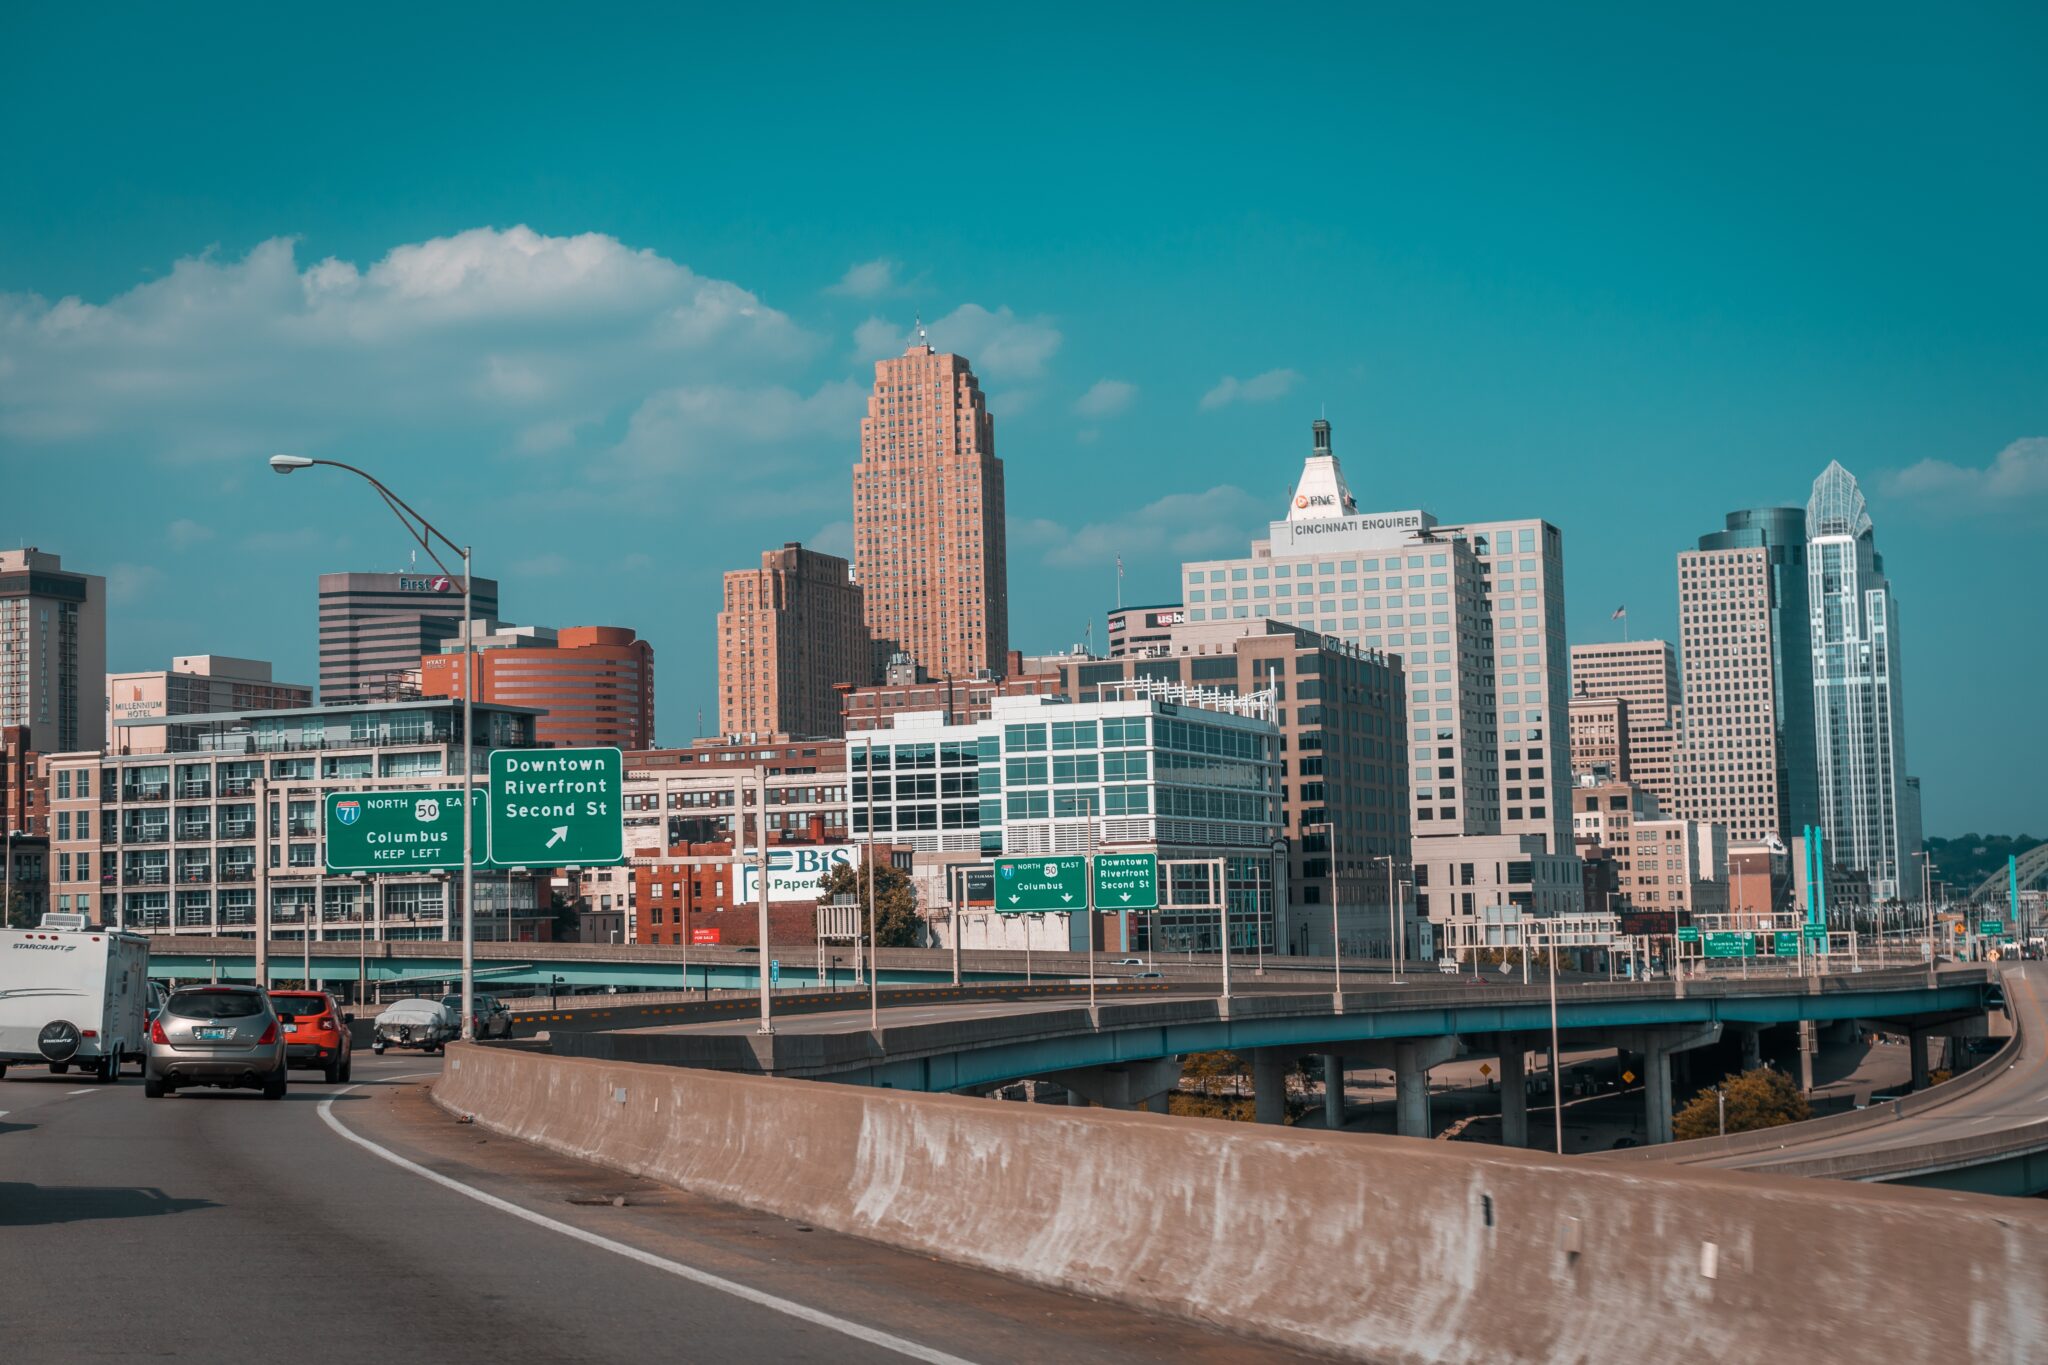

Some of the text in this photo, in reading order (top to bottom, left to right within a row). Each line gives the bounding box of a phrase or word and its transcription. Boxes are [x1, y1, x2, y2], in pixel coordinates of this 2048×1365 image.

[1310, 494, 1335, 507] PNC
[1295, 516, 1419, 536] CINCINNATI ENQUIRER
[399, 576, 431, 591] First
[426, 658, 447, 666] HYATT
[115, 701, 162, 711] MILLENNIUM
[127, 710, 152, 718] HOTEL
[506, 757, 605, 773] Downtown
[505, 778, 607, 795] Riverfront
[341, 797, 478, 821] 71 NORTH 50 EAT
[506, 801, 607, 818] Second St
[366, 830, 448, 844] Columbus
[374, 848, 441, 859] KEEP LEFT
[1101, 858, 1149, 867] Downtown
[1003, 867, 1012, 877] 71
[1045, 866, 1057, 875] 50
[1061, 861, 1079, 869] EAST
[1100, 868, 1150, 878] Riverfront
[1017, 882, 1063, 891] Columbus
[1101, 879, 1150, 890] Second St
[13, 943, 66, 951] STARCRAFT
